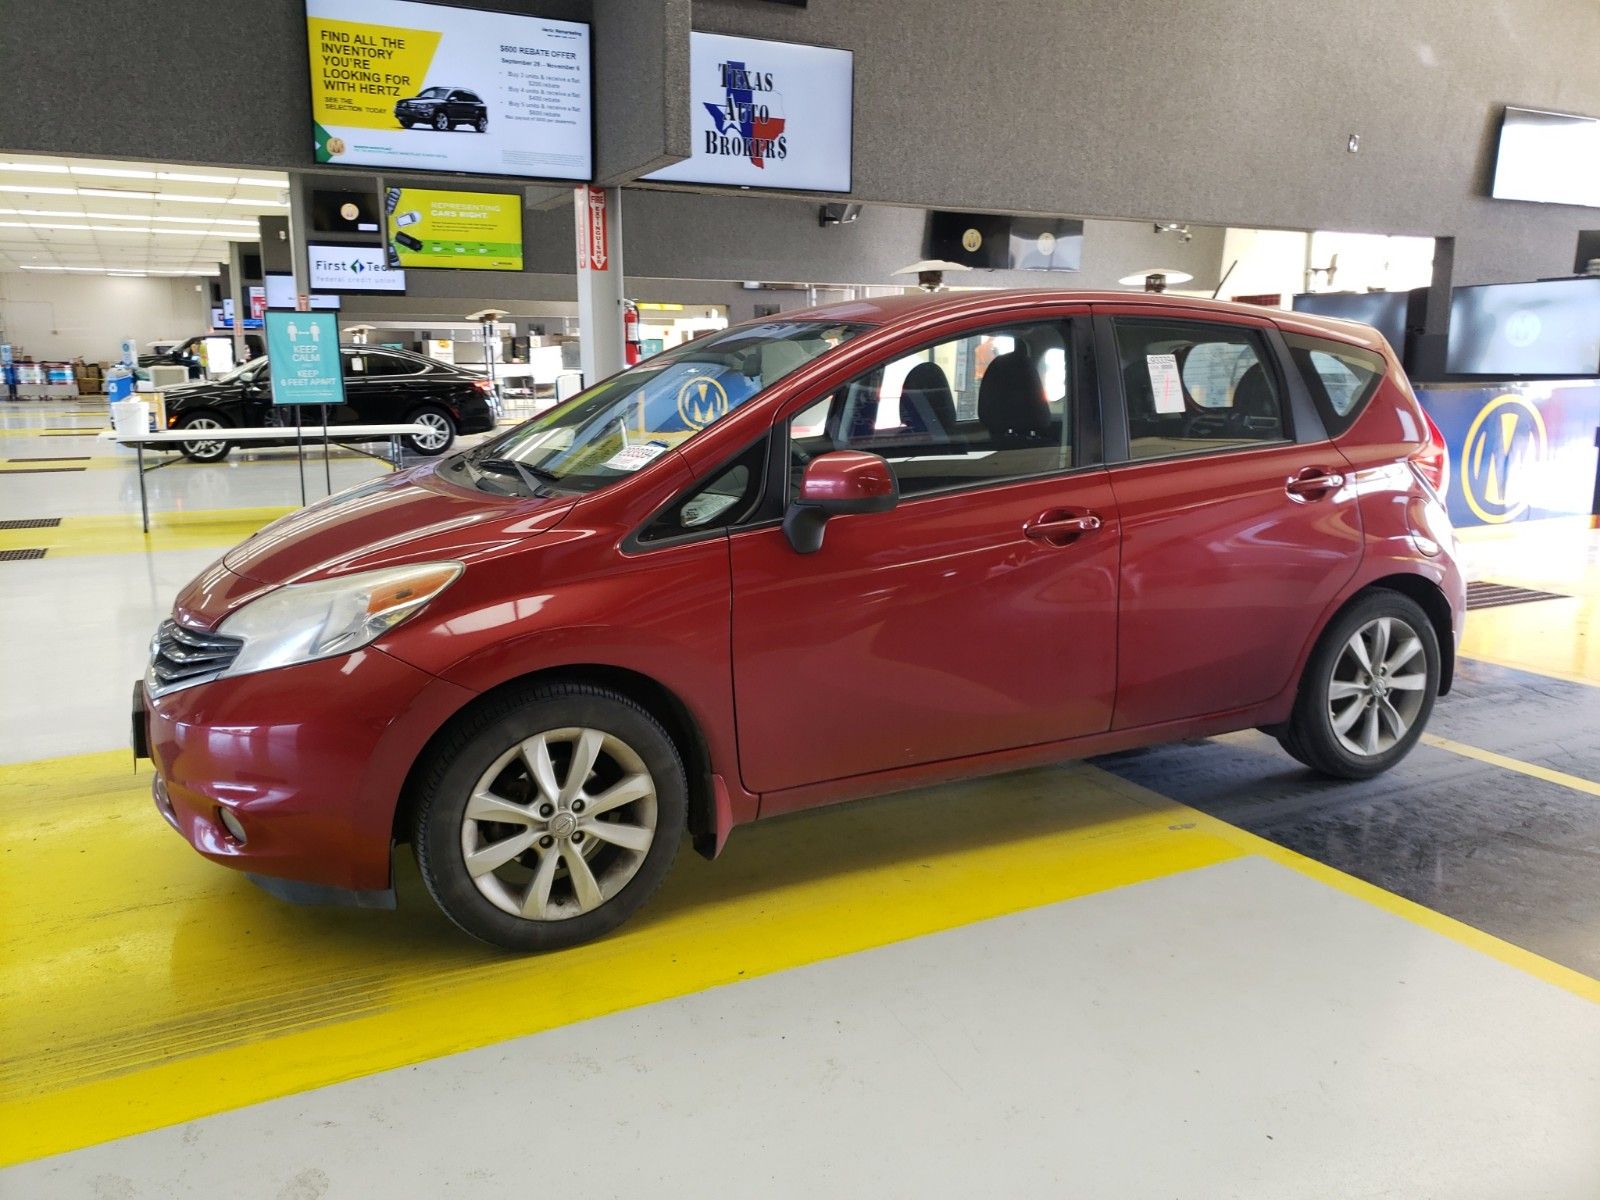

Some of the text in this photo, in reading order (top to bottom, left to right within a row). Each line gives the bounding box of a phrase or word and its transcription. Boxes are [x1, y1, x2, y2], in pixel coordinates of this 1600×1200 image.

[321, 30, 405, 50] FIND ALL THE
[321, 42, 393, 60] INVENTORY
[519, 47, 550, 57] REBATE
[551, 50, 577, 60] OFFER
[322, 55, 371, 70] YOU'RE
[323, 67, 411, 86] LOOKING FOR
[718, 62, 773, 92] TEXAS
[324, 79, 401, 97] WITH HERTZ
[723, 97, 770, 124] AUTO
[704, 129, 787, 159] BROKERS
[591, 195, 604, 204] FIRE
[431, 209, 457, 218] CARS
[316, 260, 391, 272] First Tec
[293, 345, 319, 354] KEEP
[292, 354, 321, 362] CALM
[297, 369, 320, 378] KEEP
[287, 378, 308, 386] FEET
[310, 377, 336, 386] APART
